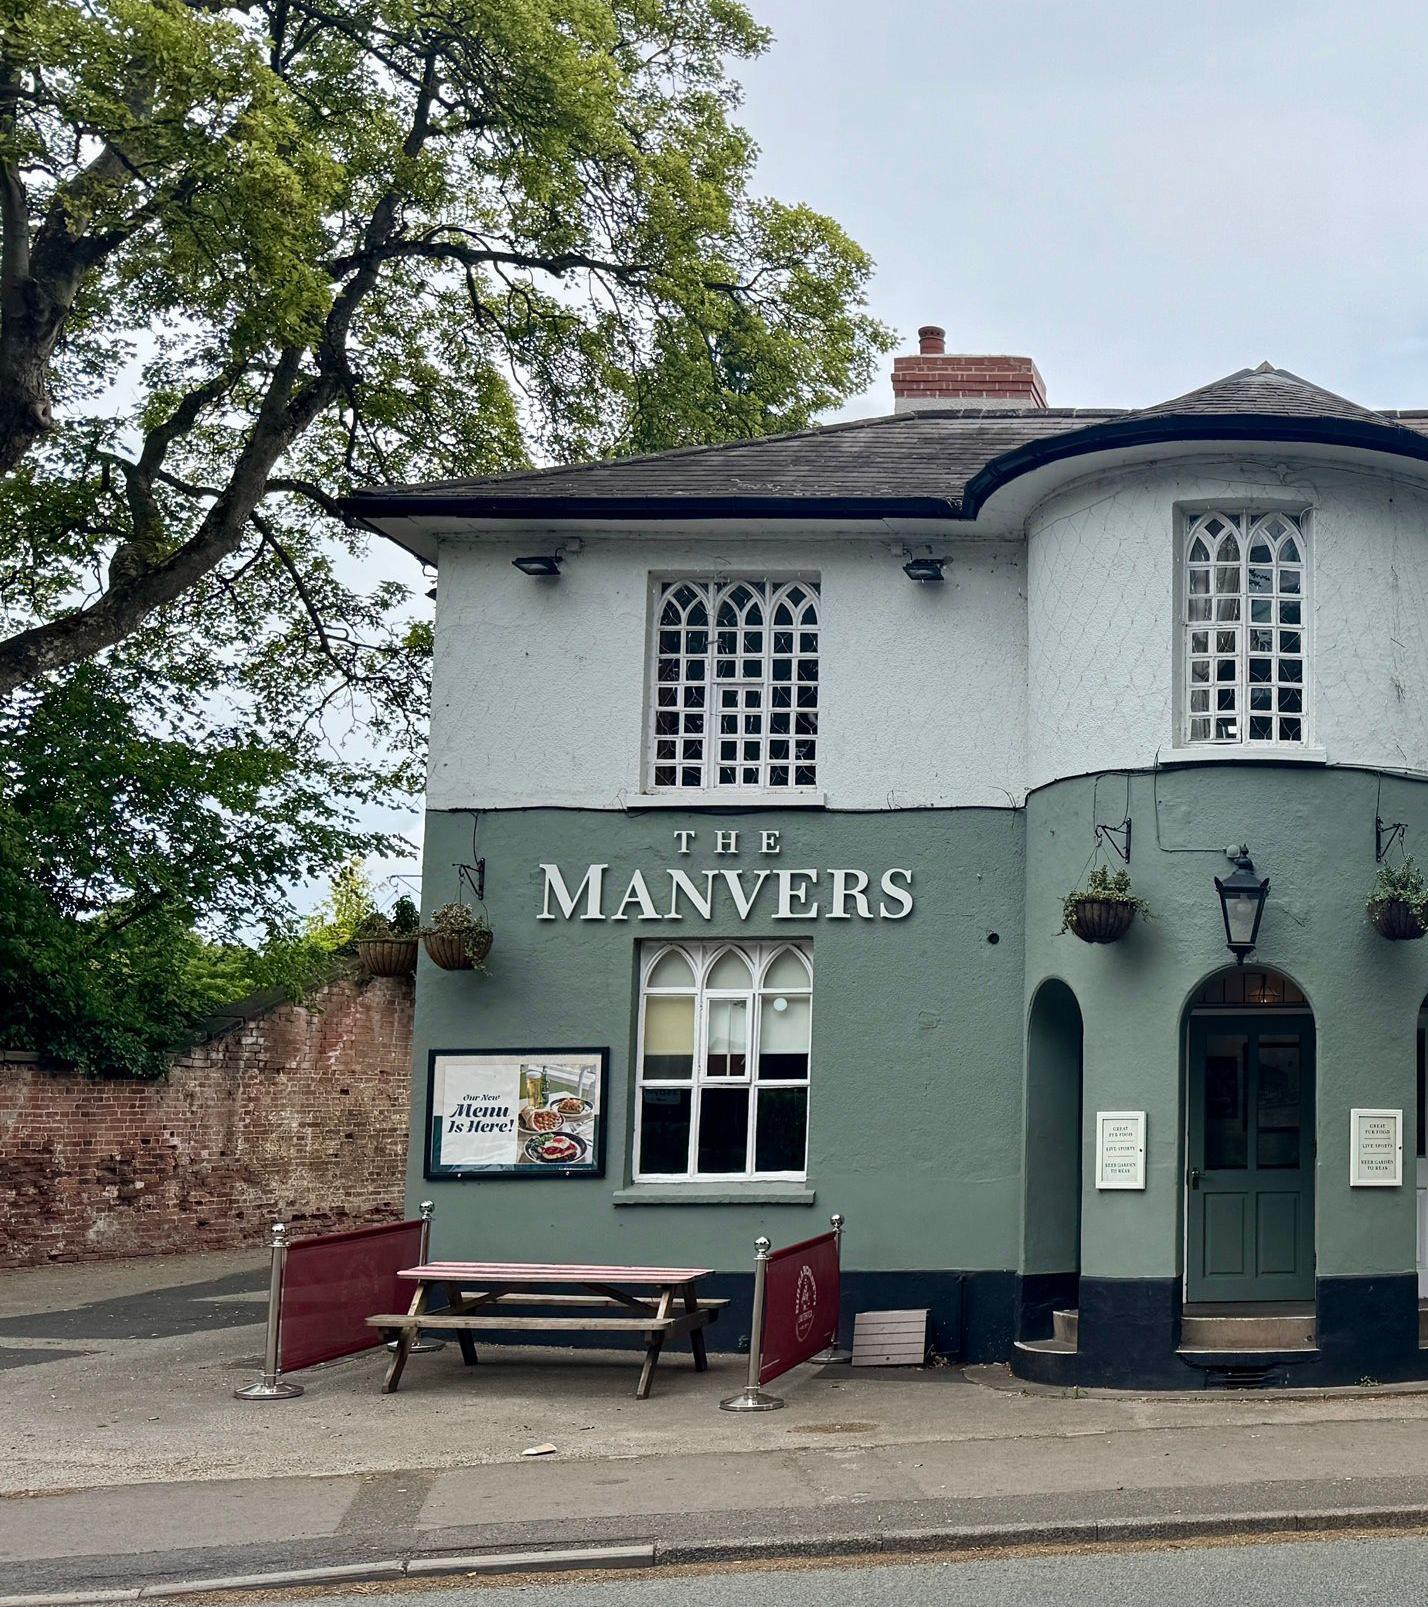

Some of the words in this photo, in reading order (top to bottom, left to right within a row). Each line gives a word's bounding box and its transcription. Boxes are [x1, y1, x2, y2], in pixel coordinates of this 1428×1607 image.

[674, 830, 781, 854] THE
[536, 863, 914, 921] MANVERS
[448, 1103, 510, 1118] Menu
[447, 1120, 465, 1133] Is
[466, 1119, 515, 1133] Here!
